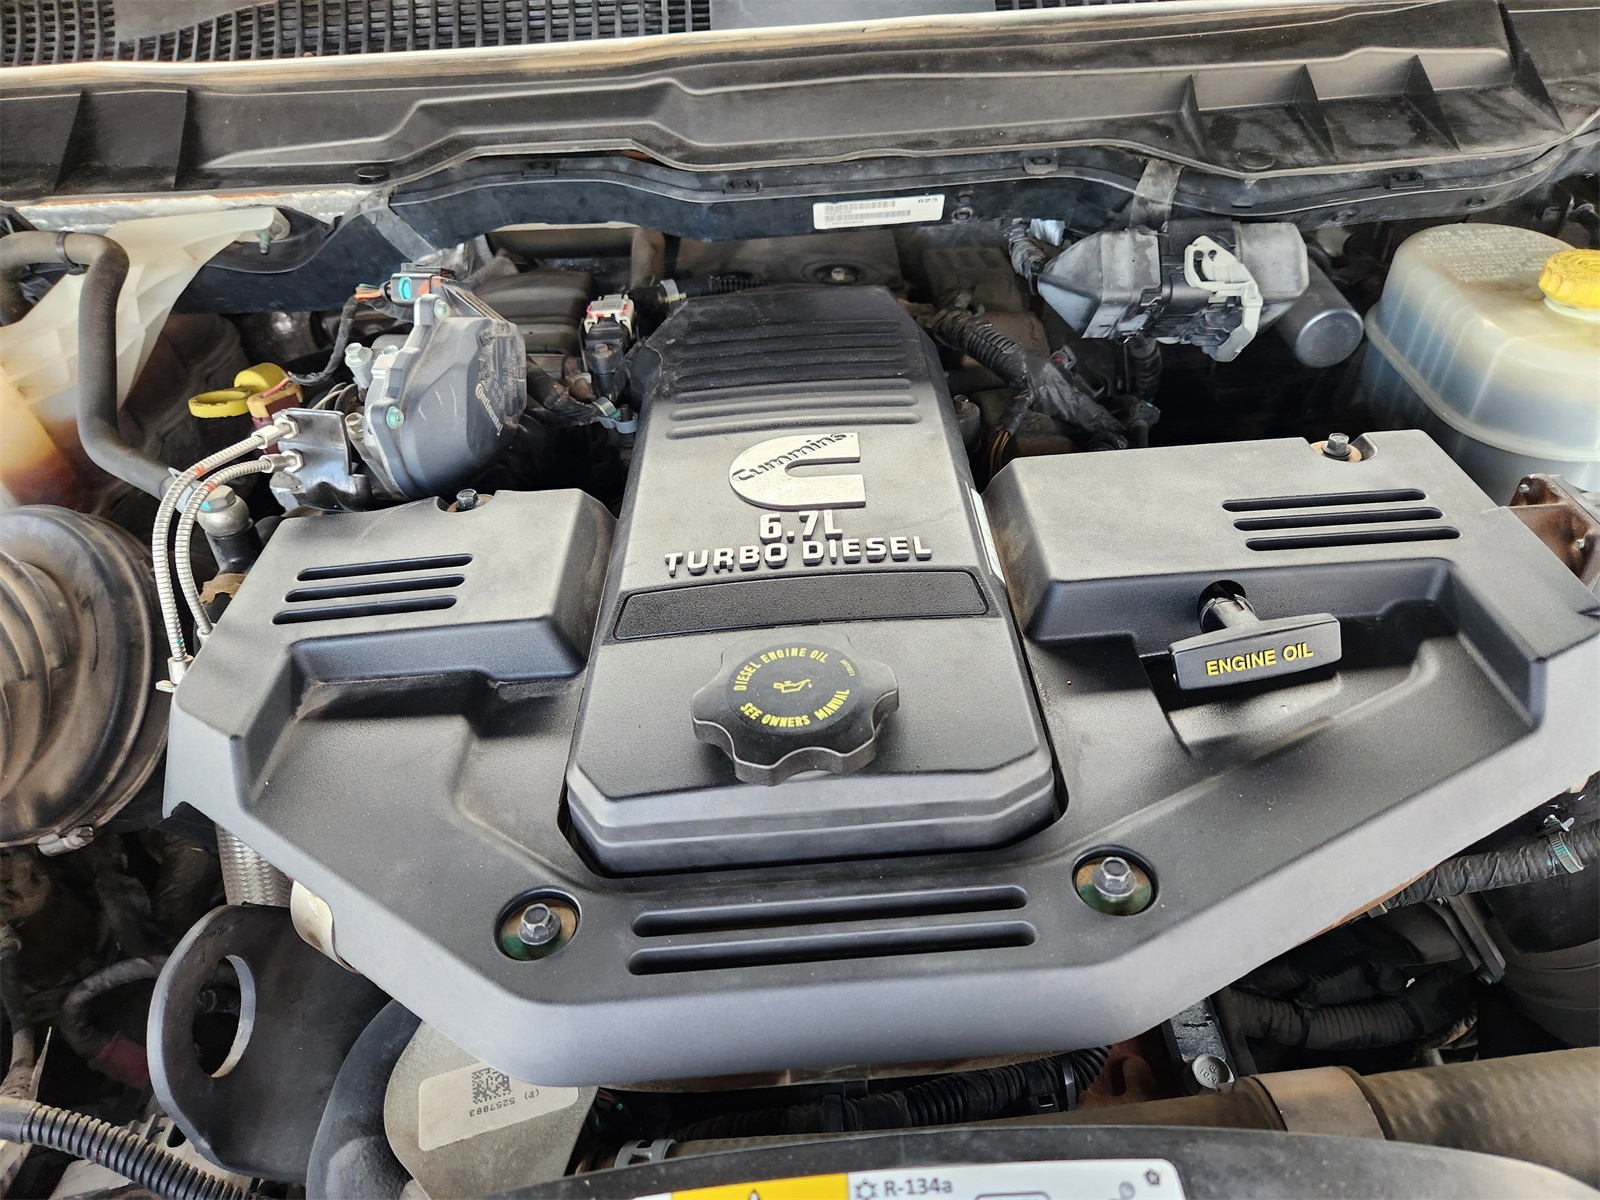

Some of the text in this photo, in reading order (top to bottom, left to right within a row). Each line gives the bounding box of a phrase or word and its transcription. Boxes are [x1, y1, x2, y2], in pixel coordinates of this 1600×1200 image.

[731, 432, 847, 481] Cummins
[759, 510, 843, 543] 6.7L
[664, 535, 932, 578] TURBO DIESEL
[733, 647, 829, 691] DIESEL ENGINE OIL
[1206, 642, 1314, 676] ENGINE OIL
[740, 689, 850, 728] SEE OWNERS MANUAL
[884, 1177, 954, 1197] R-134a
